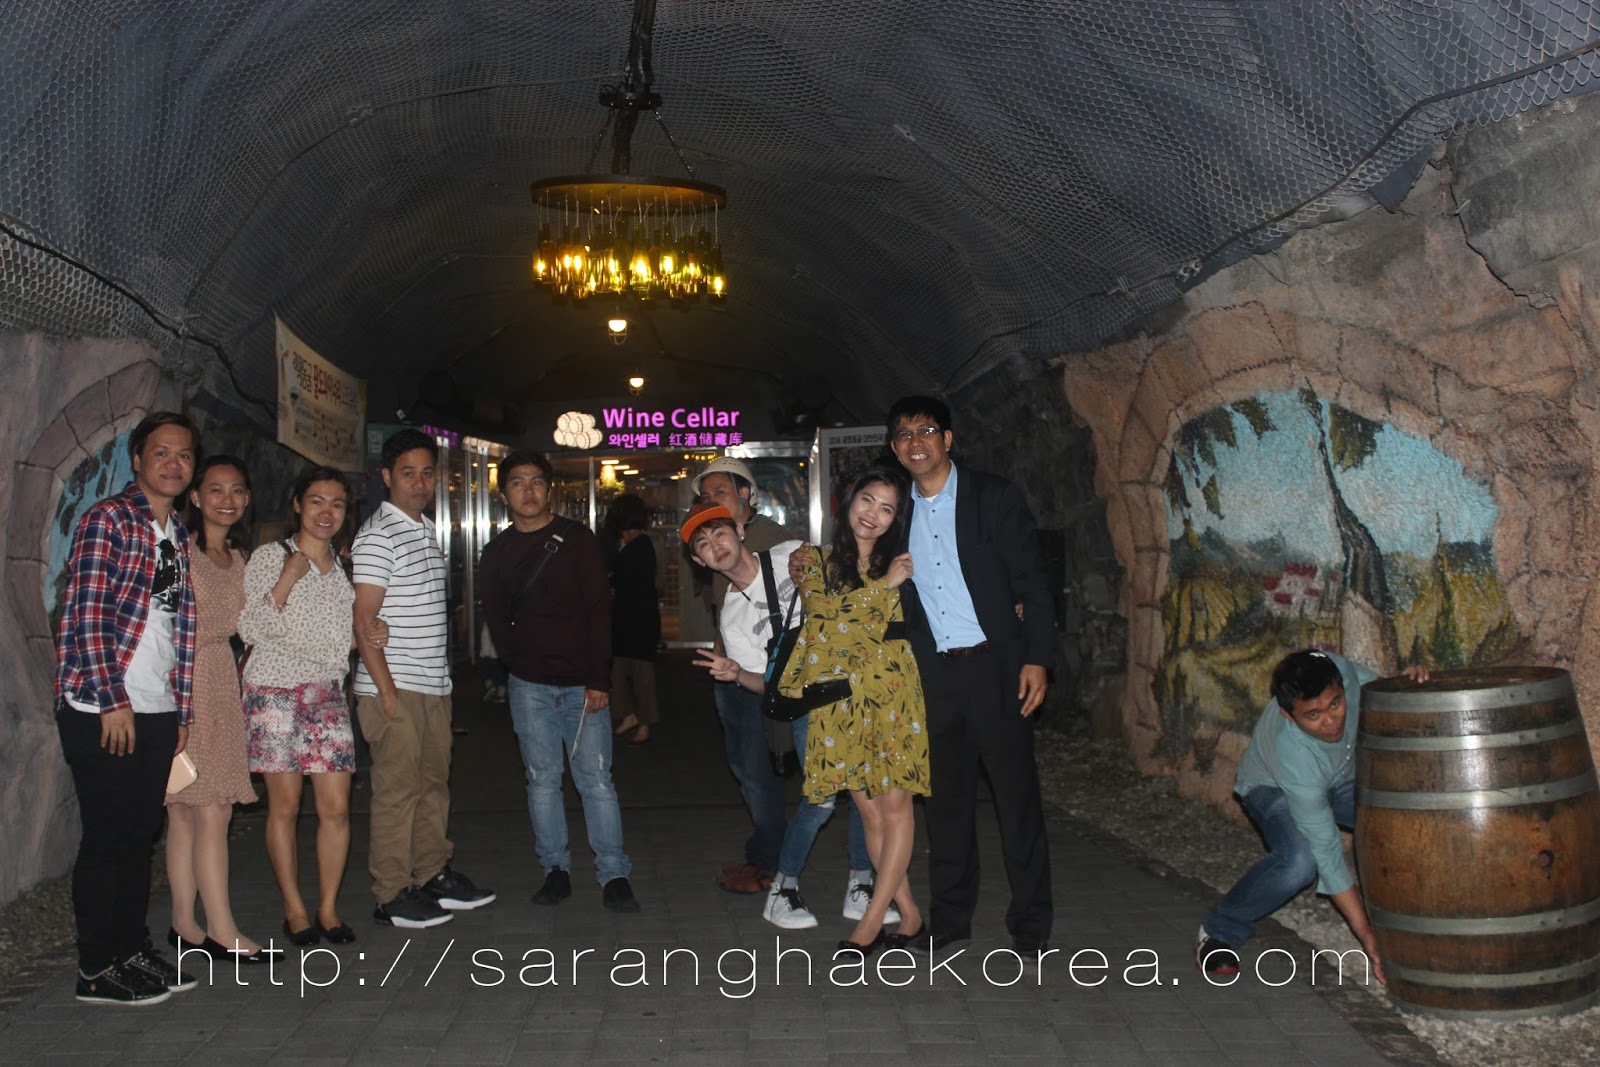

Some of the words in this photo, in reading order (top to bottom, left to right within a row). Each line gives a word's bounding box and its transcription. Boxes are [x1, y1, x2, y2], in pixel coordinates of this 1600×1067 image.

[602, 407, 665, 428] Wine
[671, 407, 740, 428] Cellar
[608, 432, 661, 448] 와인셀러
[668, 432, 743, 446] 红酒储藏库
